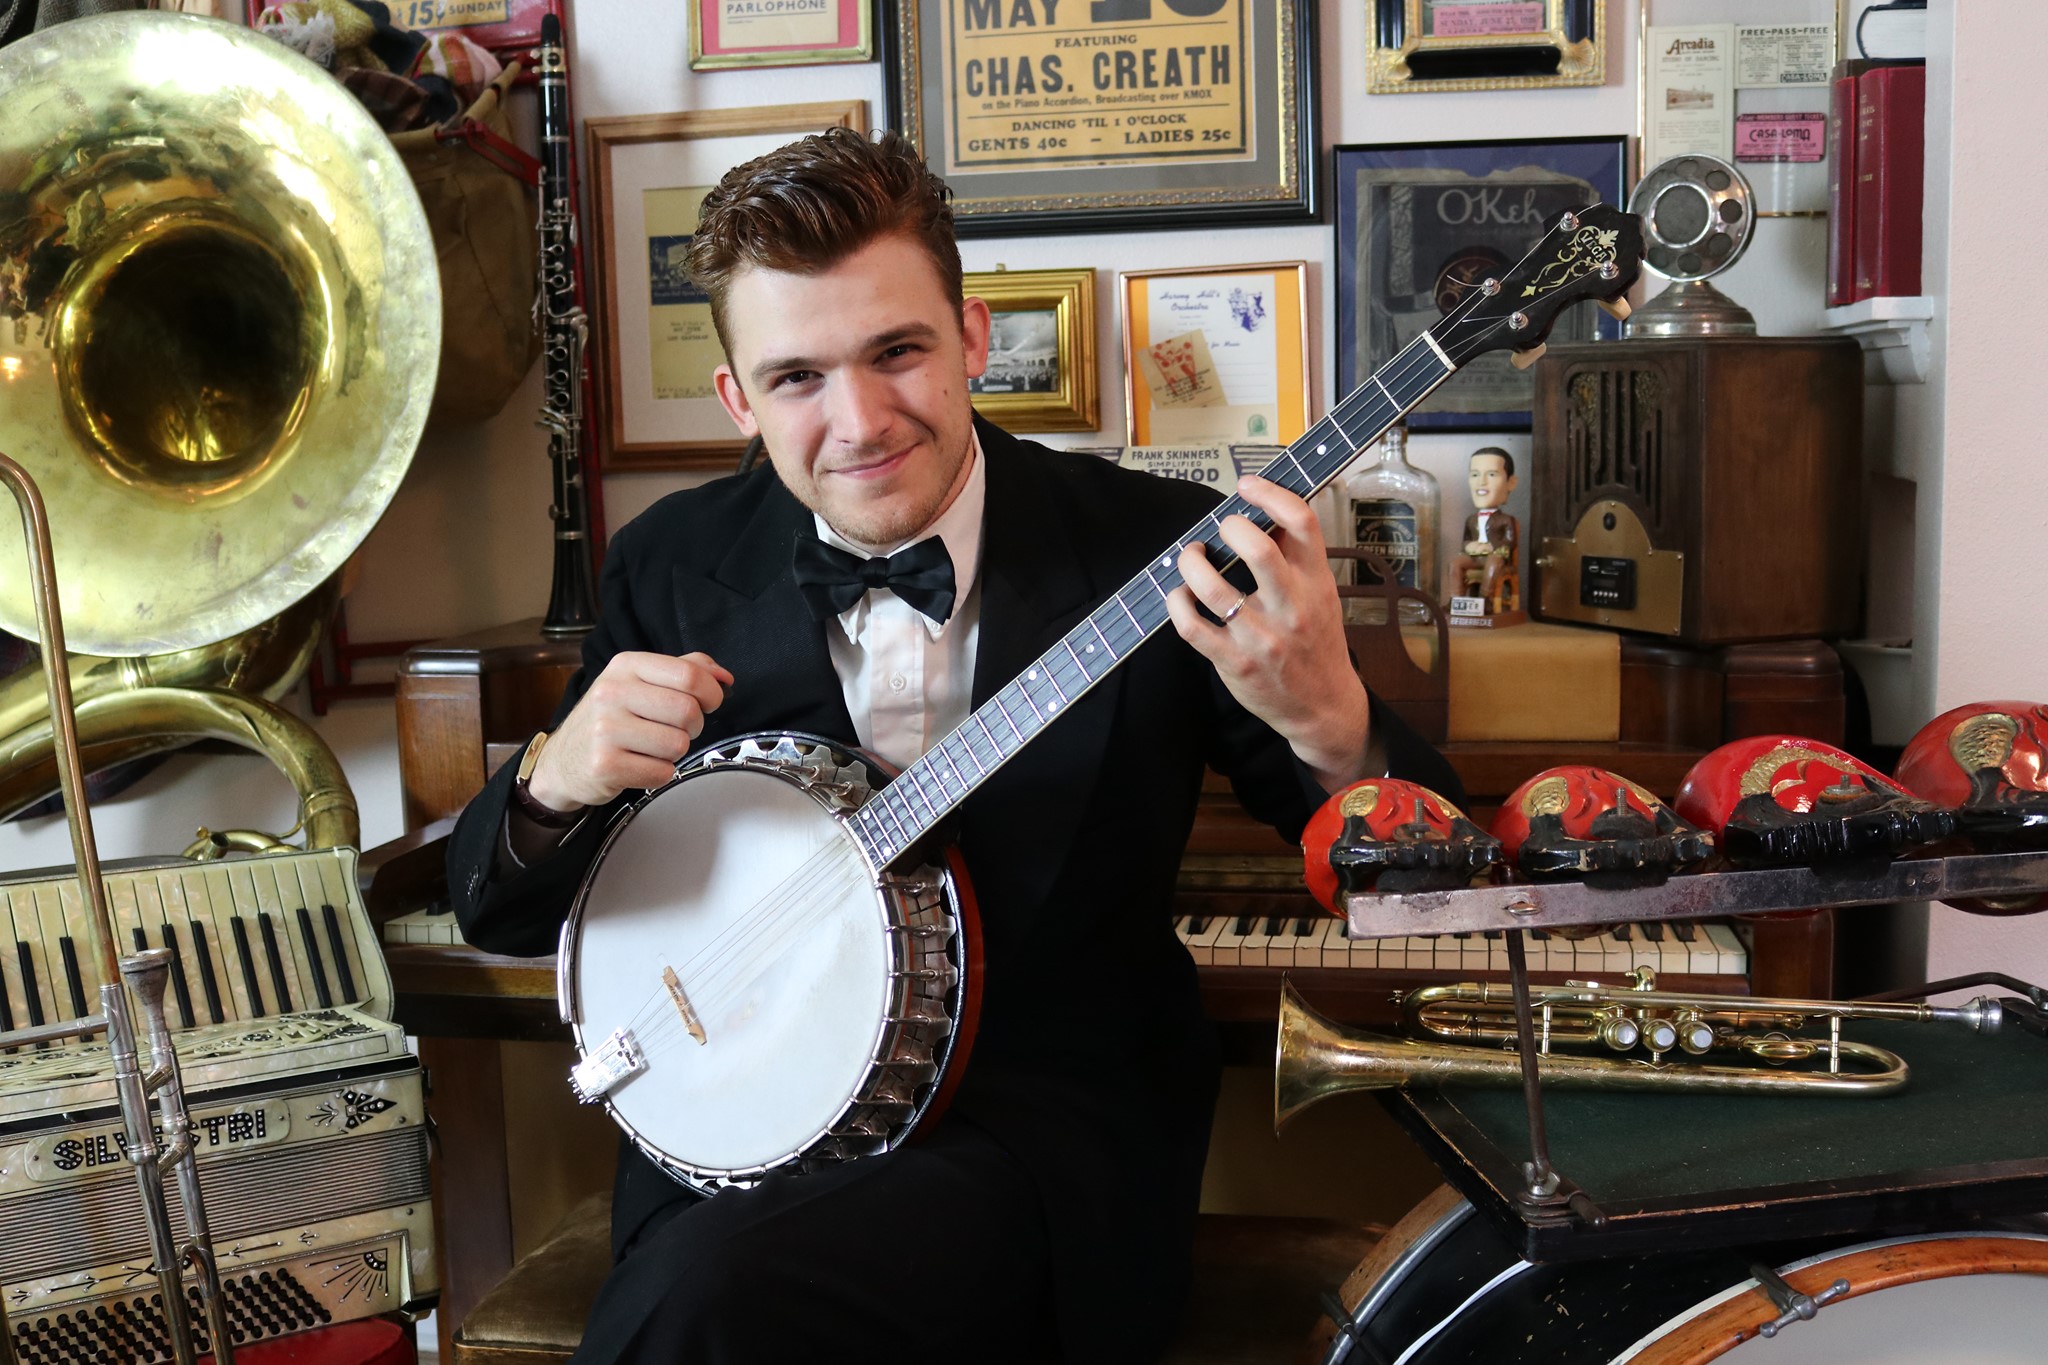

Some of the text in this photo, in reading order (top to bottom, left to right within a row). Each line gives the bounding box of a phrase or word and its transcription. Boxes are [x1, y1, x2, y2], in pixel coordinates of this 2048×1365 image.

[448, 1, 501, 14] SUNDAY
[727, 0, 826, 14] PARLOPHONE
[964, 0, 1059, 31] MAY
[1055, 34, 1137, 48] FEATURING
[1666, 37, 1715, 55] Arcadia
[965, 44, 1231, 97] CHAS. CREATH
[982, 89, 1213, 110] on the Piano Accordion, Broadcasting over KMOX
[1012, 119, 1076, 132] DANCING
[1083, 117, 1108, 128] 'TIL
[1127, 114, 1187, 126] O'CLOCK
[968, 129, 1231, 151] GENTS 40c LADIES 25c
[1580, 231, 1608, 262] VEGA
[1132, 448, 1219, 460] FRANK SKINNER'S
[1142, 468, 1219, 482] ETHOD
